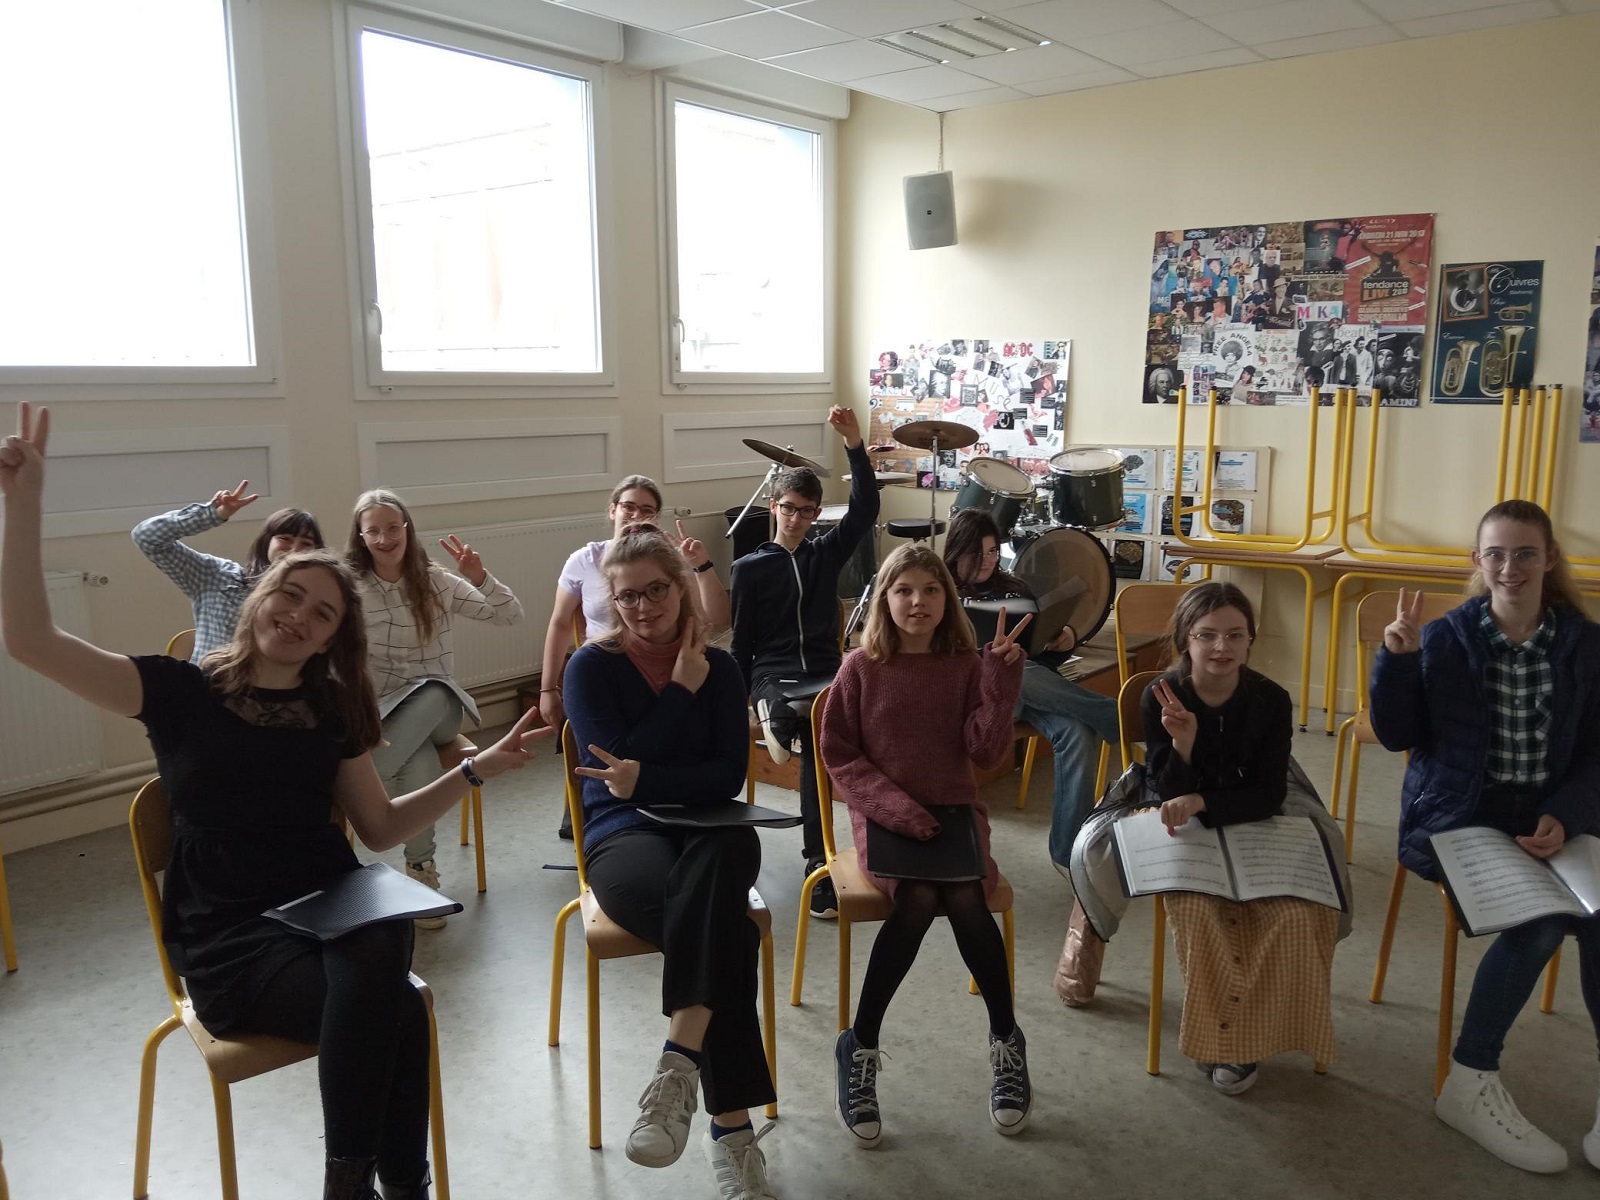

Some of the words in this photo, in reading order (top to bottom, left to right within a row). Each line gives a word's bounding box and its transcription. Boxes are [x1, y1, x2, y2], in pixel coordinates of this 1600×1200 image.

[1363, 281, 1409, 289] tendance
[1484, 264, 1540, 294] Cuivres
[1363, 288, 1390, 301] LIVE
[1230, 332, 1253, 357] ANGELA
